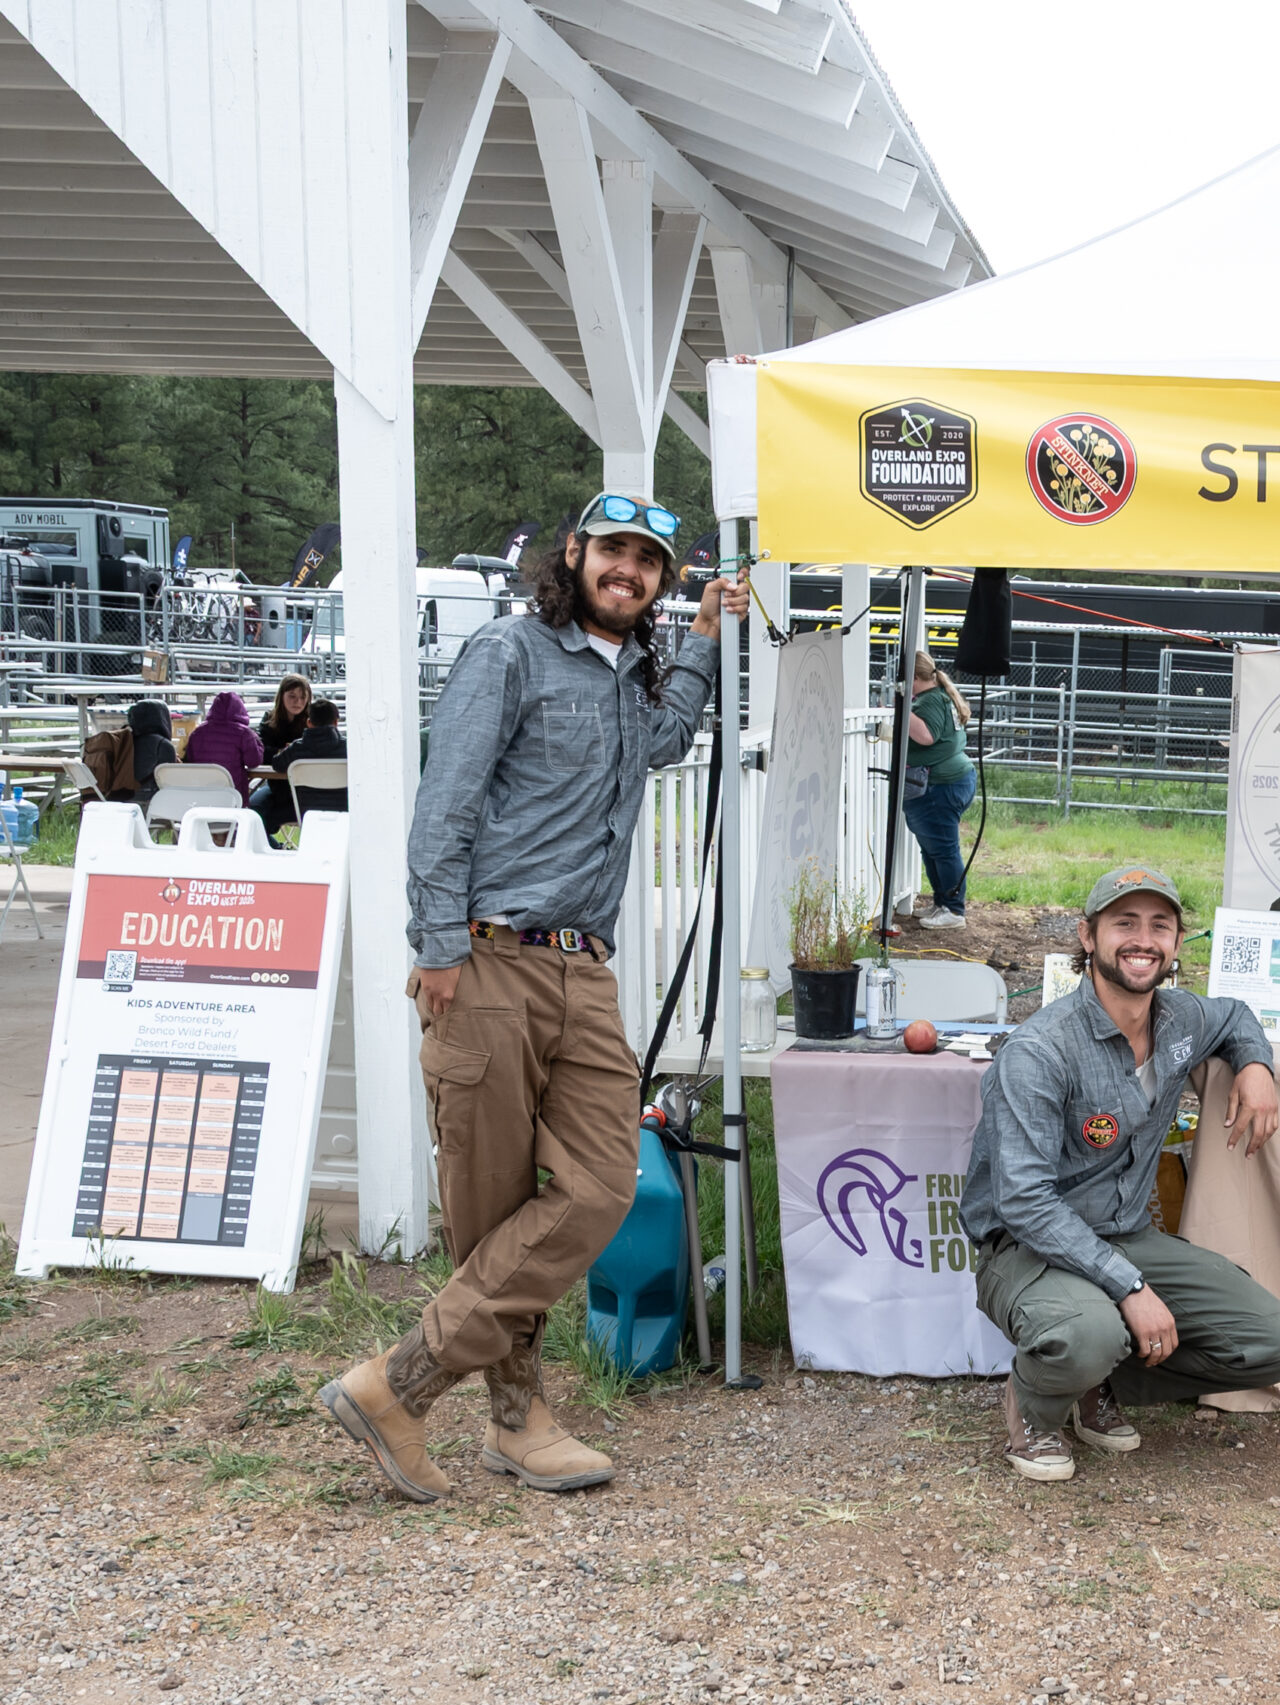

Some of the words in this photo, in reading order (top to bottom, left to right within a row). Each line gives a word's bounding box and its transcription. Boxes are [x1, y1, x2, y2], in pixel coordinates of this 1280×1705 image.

[875, 430, 892, 438] EST.
[872, 448, 932, 462] OVERLAND
[936, 450, 965, 462] EXPO
[1051, 436, 1109, 496] STINKNET
[872, 463, 966, 485] FOUNDATION
[883, 494, 915, 502] PROTECT
[903, 504, 935, 512] EXPLORE
[15, 513, 33, 524] ADV
[36, 514, 66, 525] MOBIL
[189, 880, 255, 895] OVERLAND
[187, 894, 219, 906] EXPO
[120, 912, 284, 951] EDUCATION
[128, 999, 152, 1008] KIDS
[156, 1001, 223, 1012] ADVENTURE
[226, 1004, 256, 1014] AREA
[154, 1012, 210, 1025] Sponsored
[212, 1014, 224, 1026] by
[138, 1026, 175, 1036] Bronco
[178, 1027, 201, 1037] Wild
[204, 1028, 231, 1038] Fund
[134, 1038, 168, 1048] Desert
[172, 1040, 195, 1050] Ford
[198, 1041, 237, 1052] Dealers
